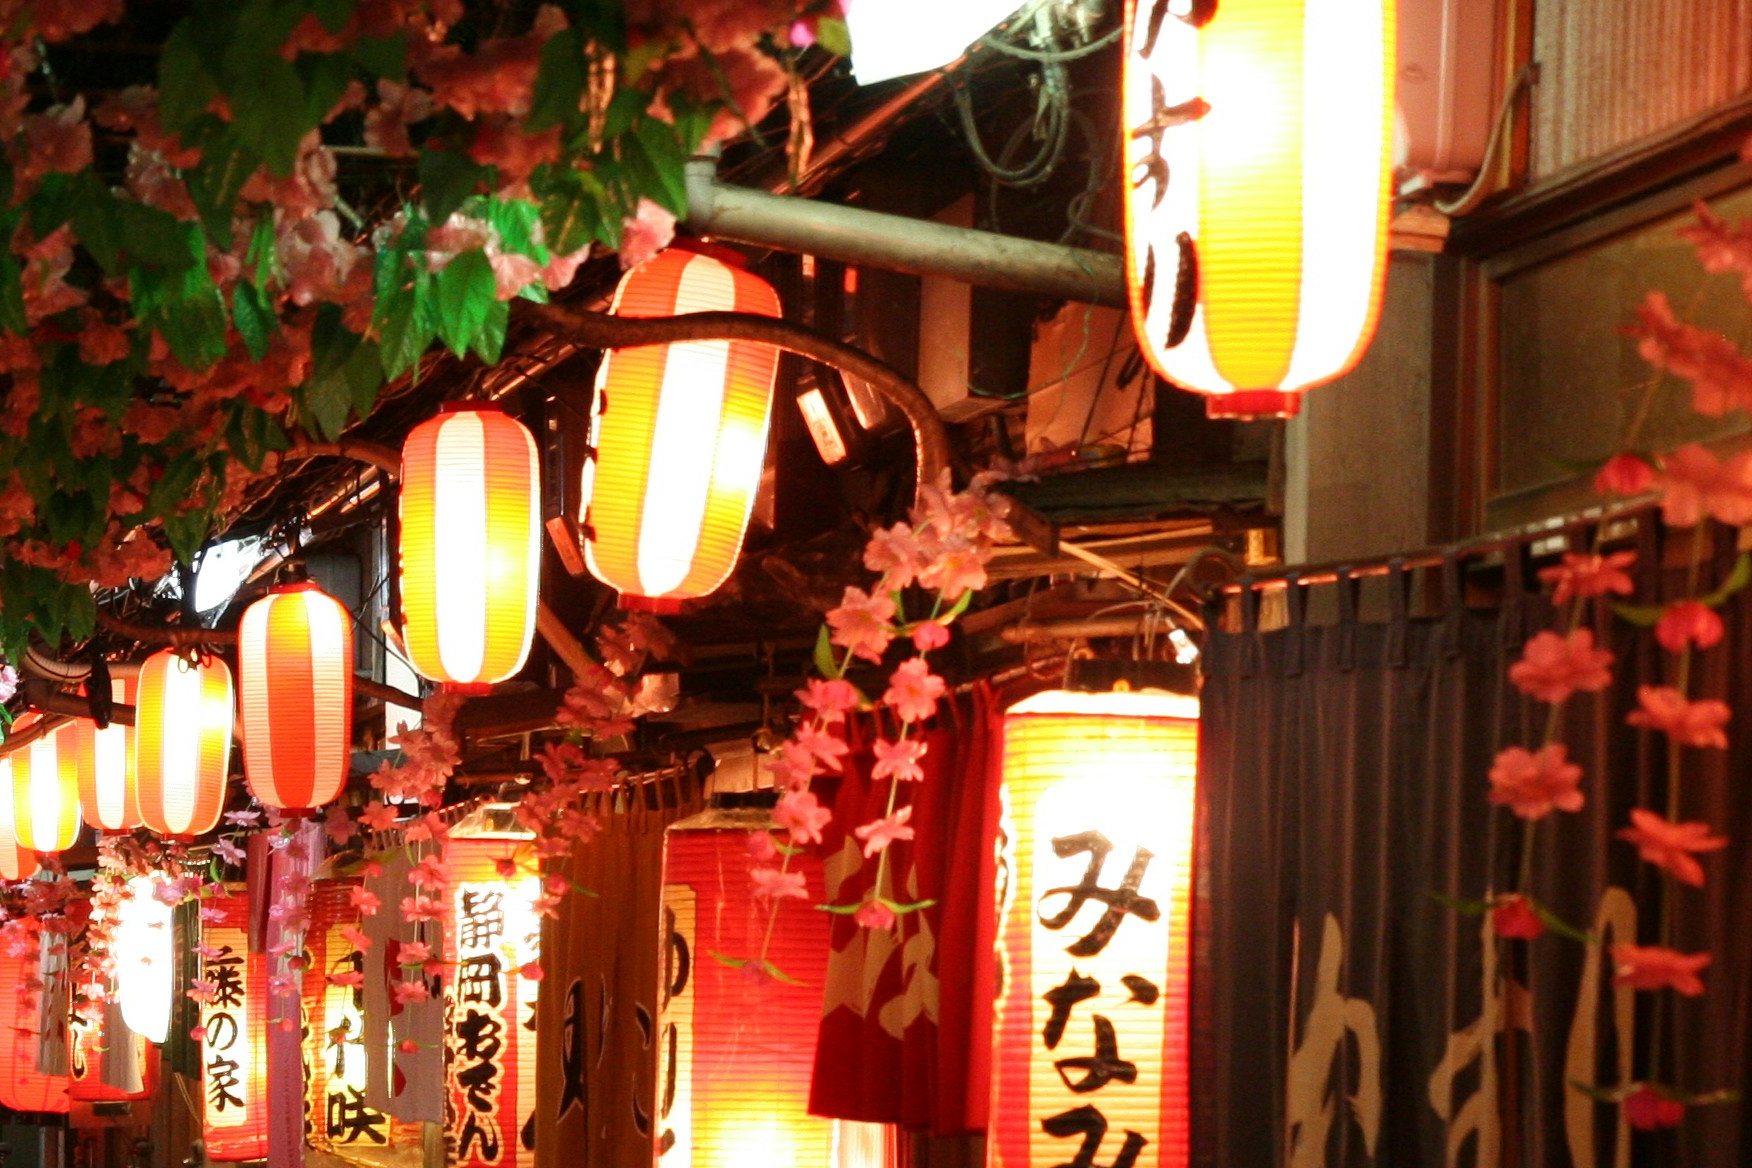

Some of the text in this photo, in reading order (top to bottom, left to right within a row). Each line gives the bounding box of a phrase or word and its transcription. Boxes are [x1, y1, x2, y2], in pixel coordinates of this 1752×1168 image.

[457, 888, 505, 1162] 静岡おでん
